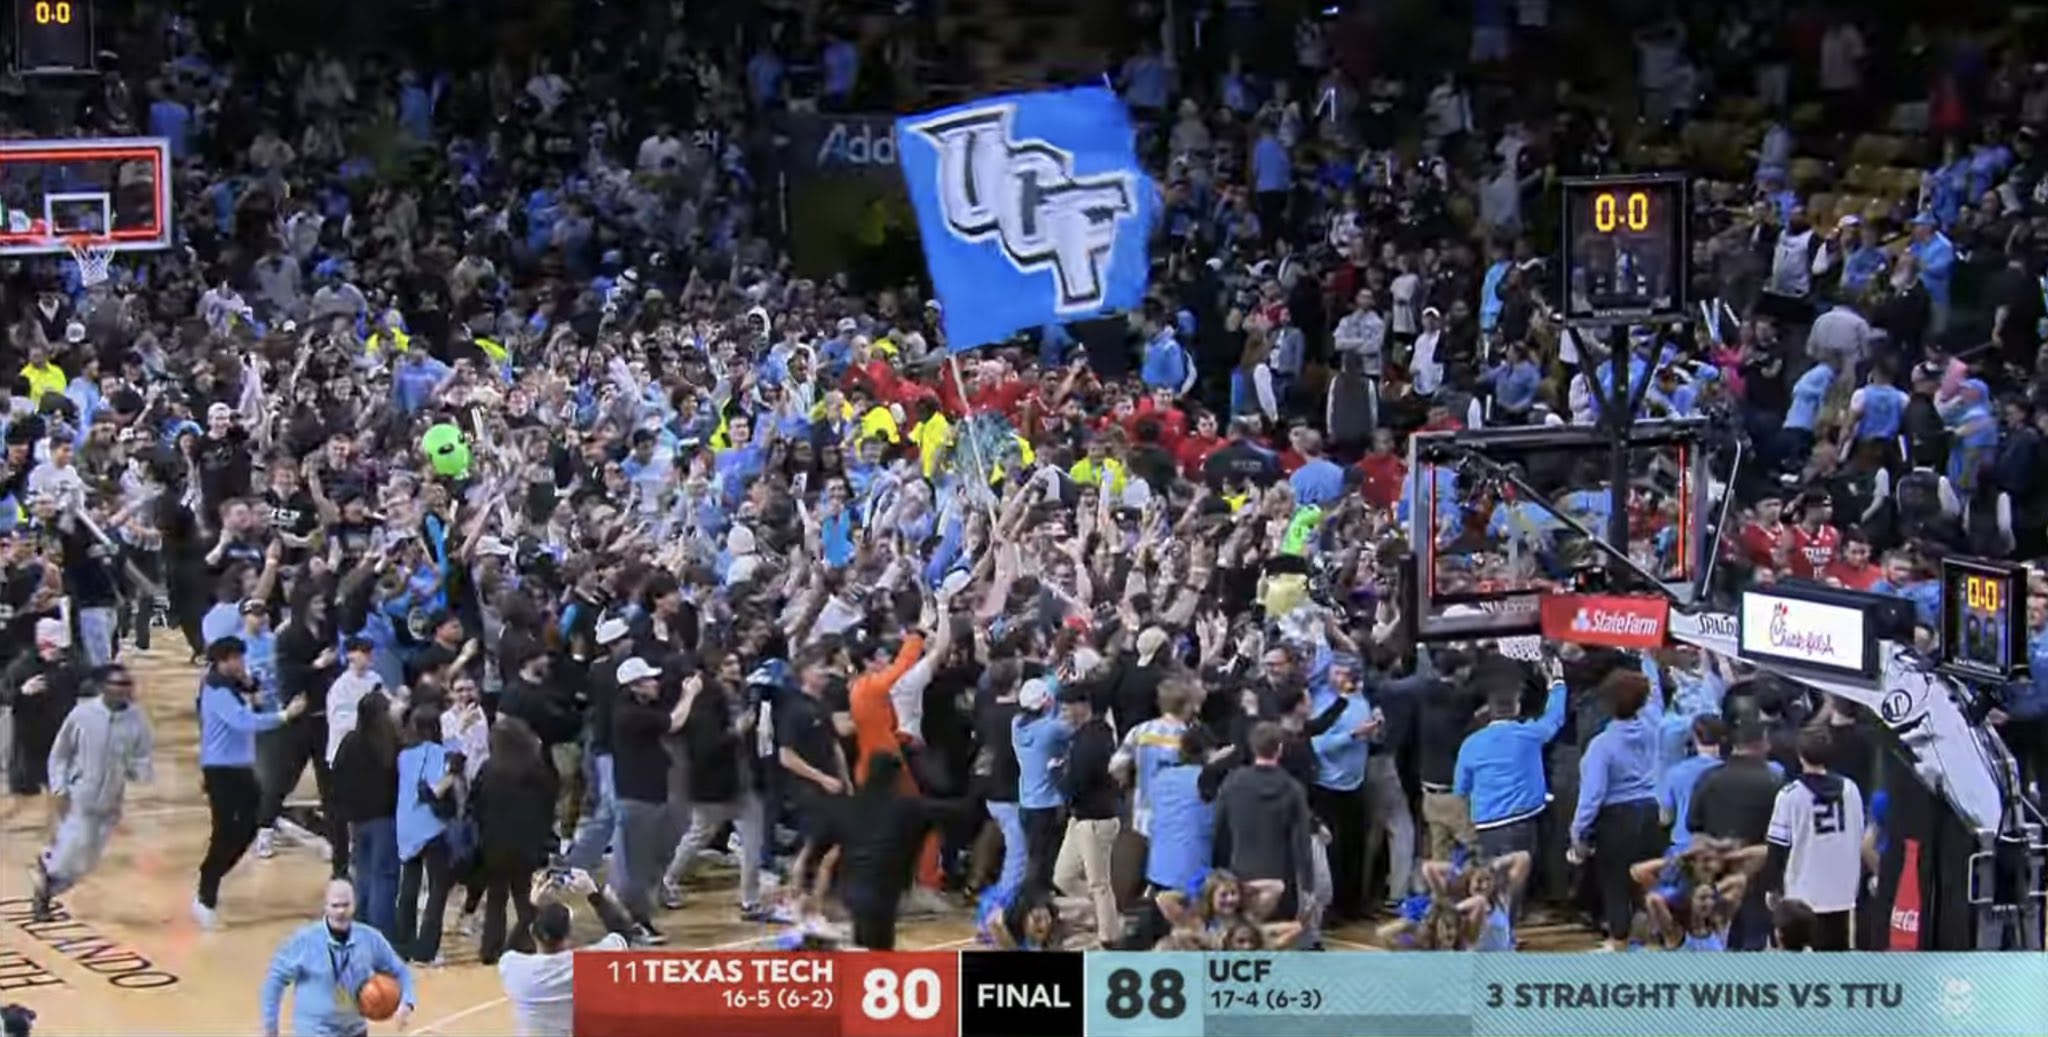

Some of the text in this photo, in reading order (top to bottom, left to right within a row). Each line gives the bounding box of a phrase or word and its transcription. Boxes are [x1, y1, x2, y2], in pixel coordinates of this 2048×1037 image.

[35, 2, 71, 23] 0.0
[905, 102, 1137, 314] UCF
[1595, 192, 1648, 232] 0.0
[1967, 576, 1998, 612] 0.0
[1699, 614, 1738, 635] SPALD
[1813, 797, 1846, 835] 21
